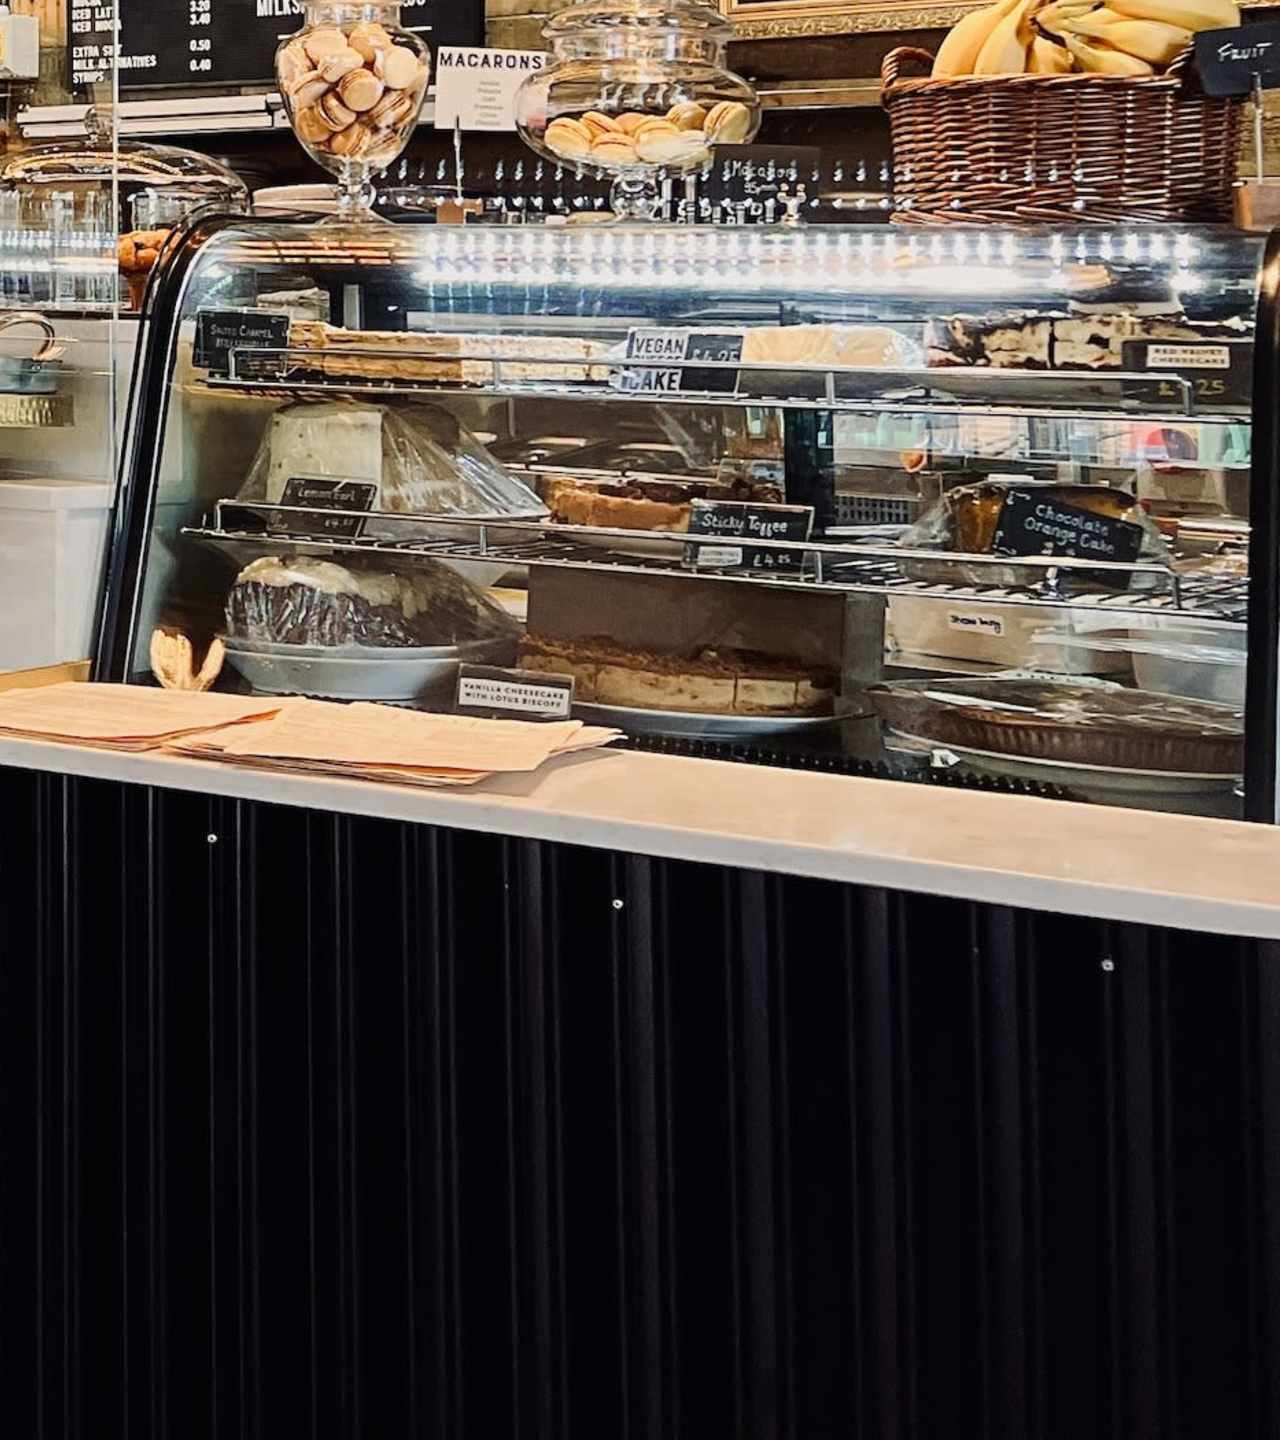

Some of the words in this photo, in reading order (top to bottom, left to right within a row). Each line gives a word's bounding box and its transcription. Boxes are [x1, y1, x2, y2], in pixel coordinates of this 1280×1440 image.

[73, 46, 99, 58] EXTRA
[190, 40, 211, 51] 0.50
[440, 52, 542, 69] MACARONS
[636, 338, 684, 353] VEGAN
[630, 371, 678, 390] CAKE
[702, 513, 744, 534] Sticky
[748, 516, 788, 536] Toffee
[1035, 505, 1108, 537] Chocolate
[1024, 517, 1075, 545] Orange
[1080, 534, 1115, 554] Cake
[464, 684, 501, 692] VANILLA
[504, 688, 564, 699] CHEESECAKE
[491, 695, 518, 703] LOTUS
[523, 698, 560, 707] BISCOFF
